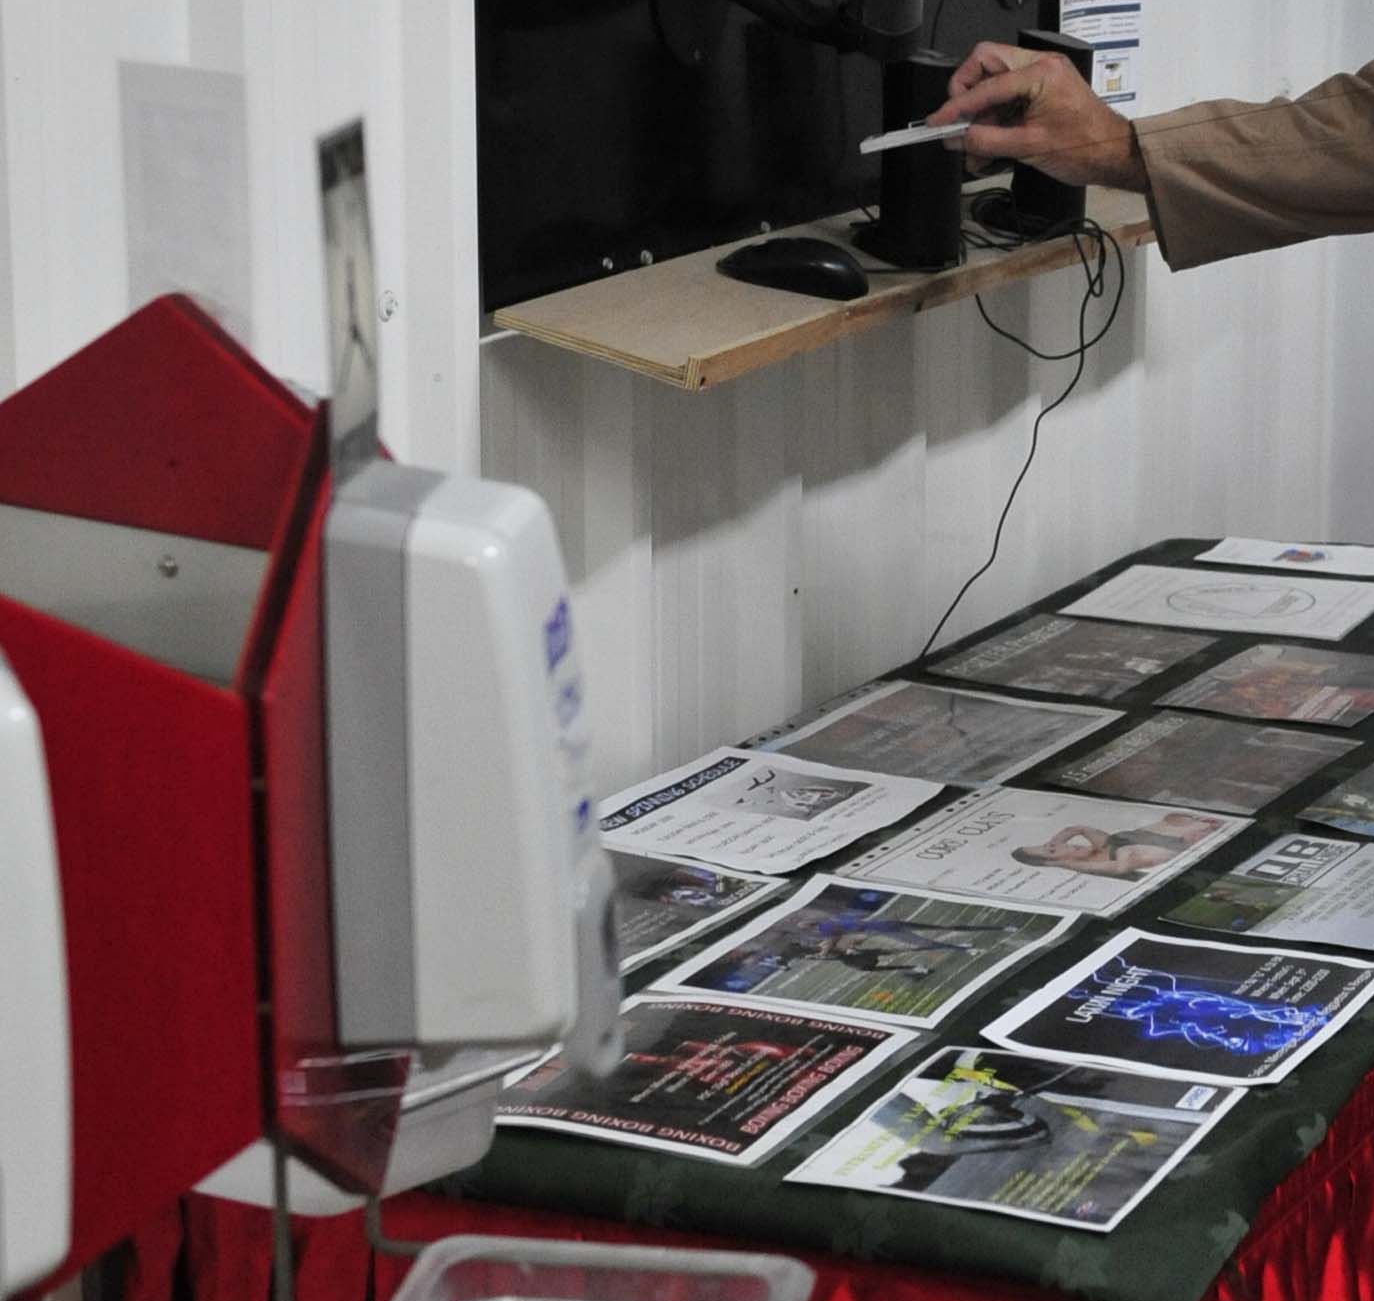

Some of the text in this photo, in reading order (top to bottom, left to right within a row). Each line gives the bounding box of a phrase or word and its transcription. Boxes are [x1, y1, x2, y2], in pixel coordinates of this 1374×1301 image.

[1065, 965, 1152, 1024] LATIN NIGHT
[648, 1001, 887, 1040] BOXING BOXING BOXING
[497, 1105, 742, 1152] BOXING BOXING BOXIN
